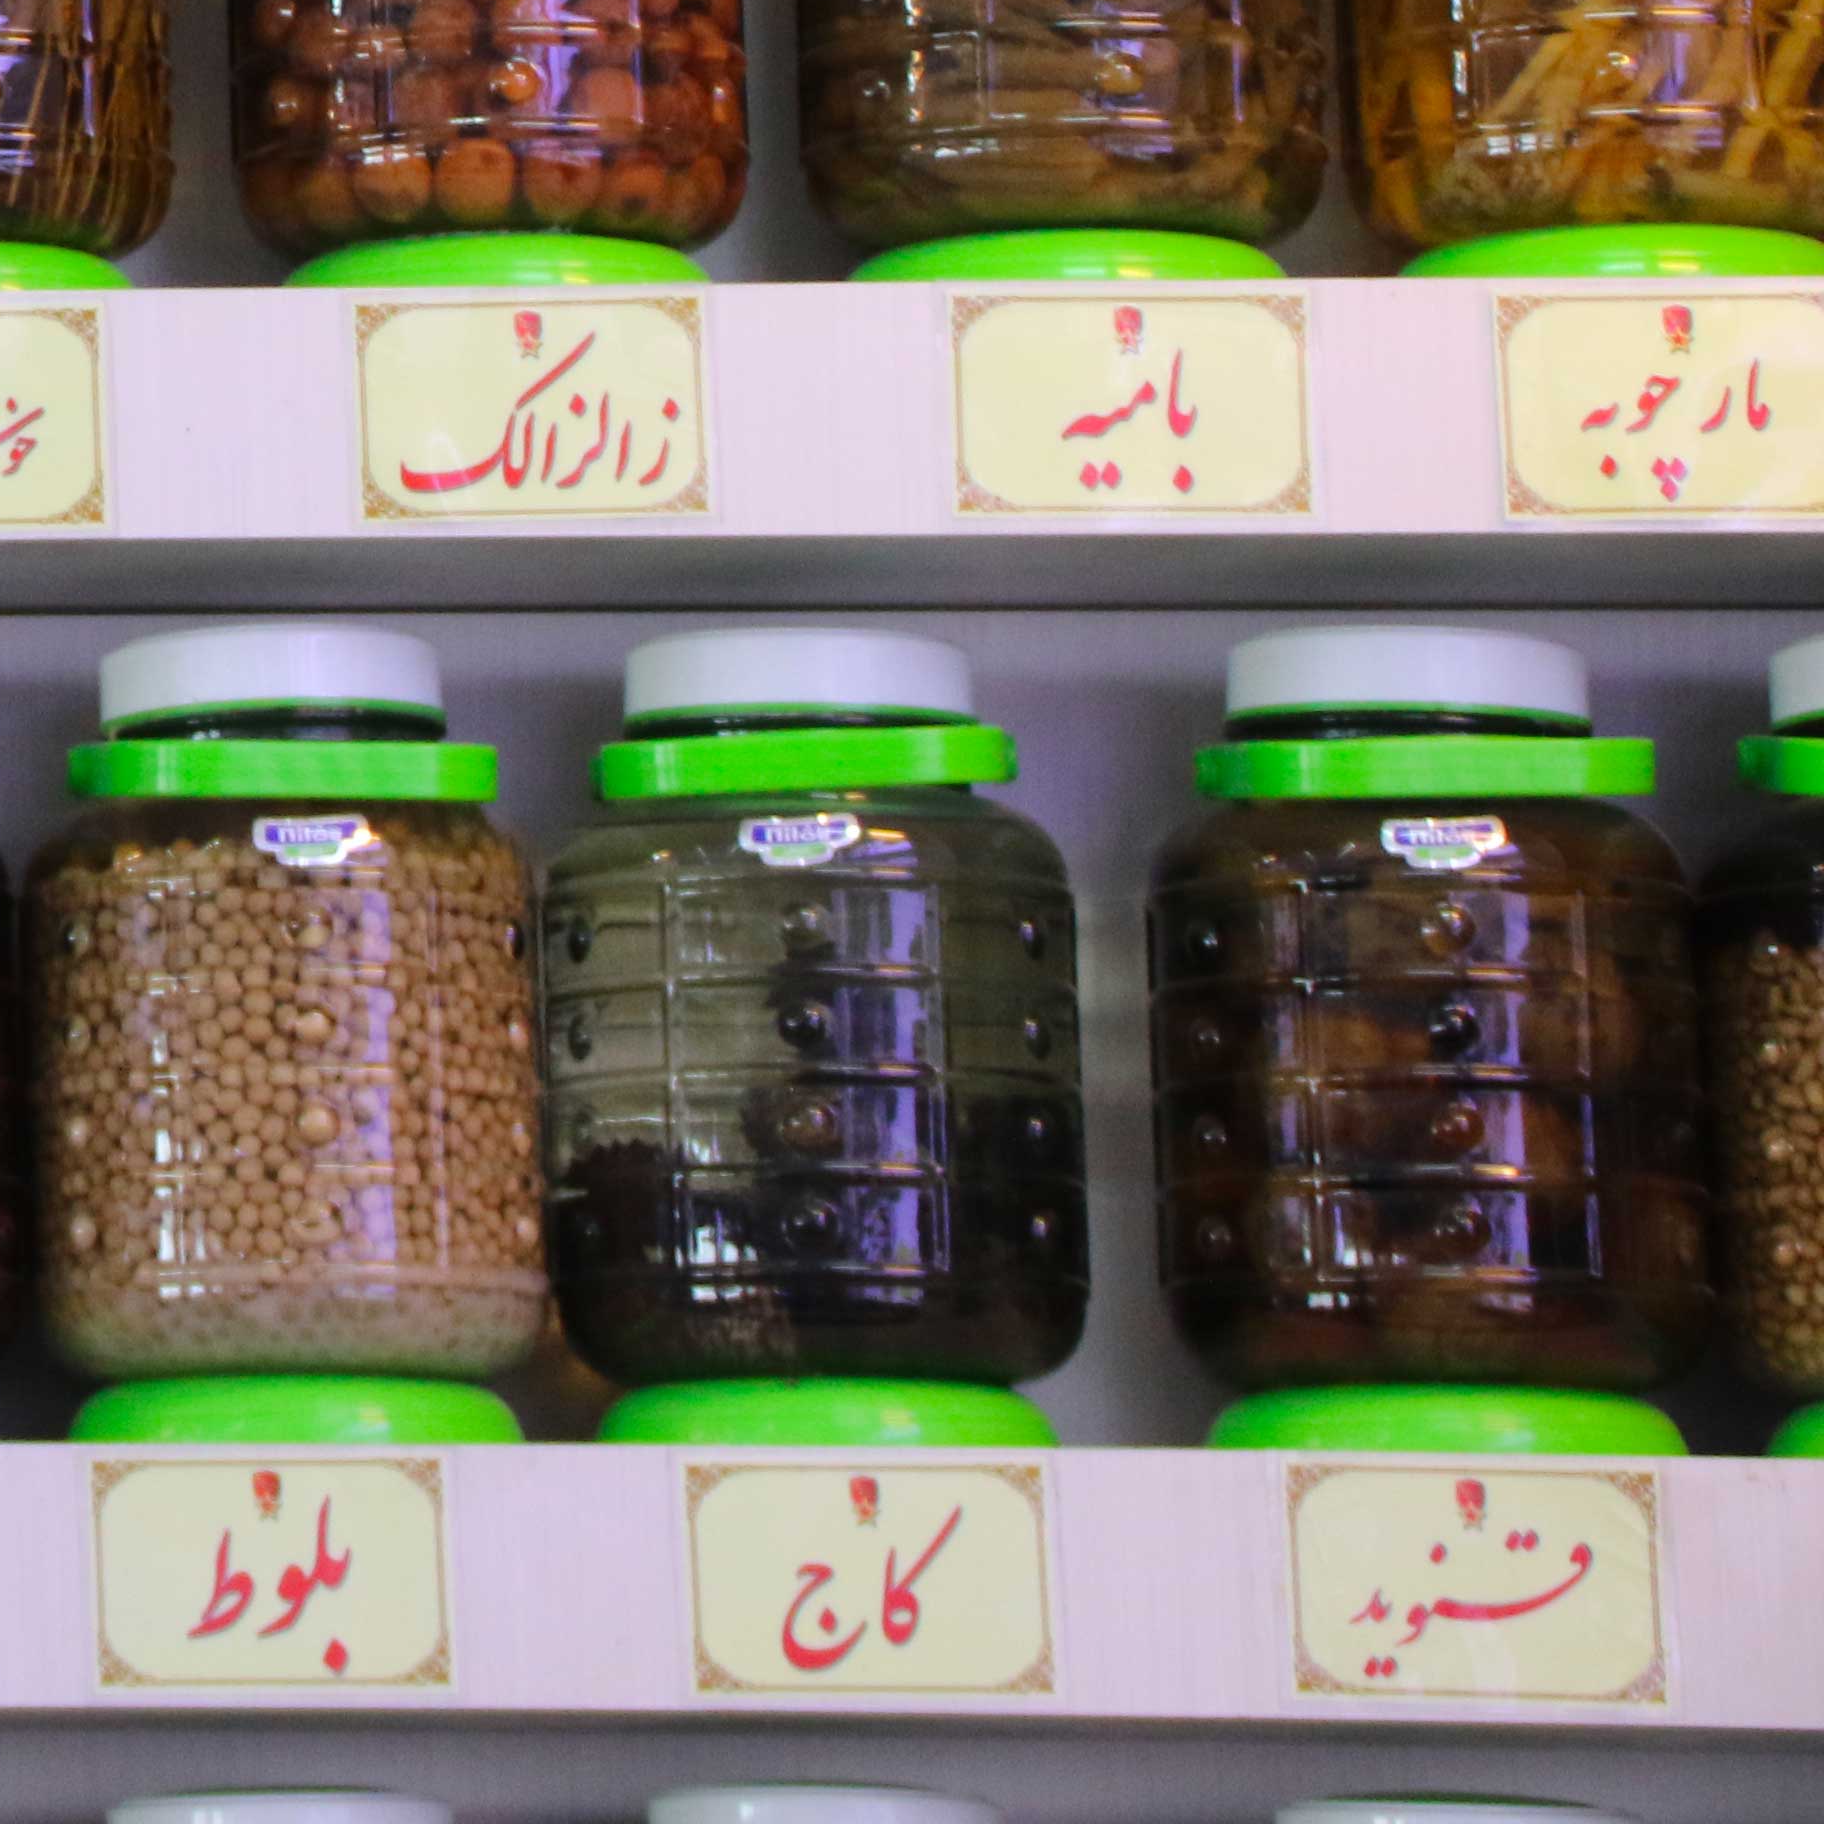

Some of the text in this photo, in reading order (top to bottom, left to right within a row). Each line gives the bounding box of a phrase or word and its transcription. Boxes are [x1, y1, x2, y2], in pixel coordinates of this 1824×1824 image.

[398, 331, 683, 496] زالزالک
[1059, 349, 1200, 496] بامیه
[1578, 360, 1775, 505] مارچوبه
[186, 1494, 352, 1683] بلوط
[779, 1504, 964, 1675] کاج
